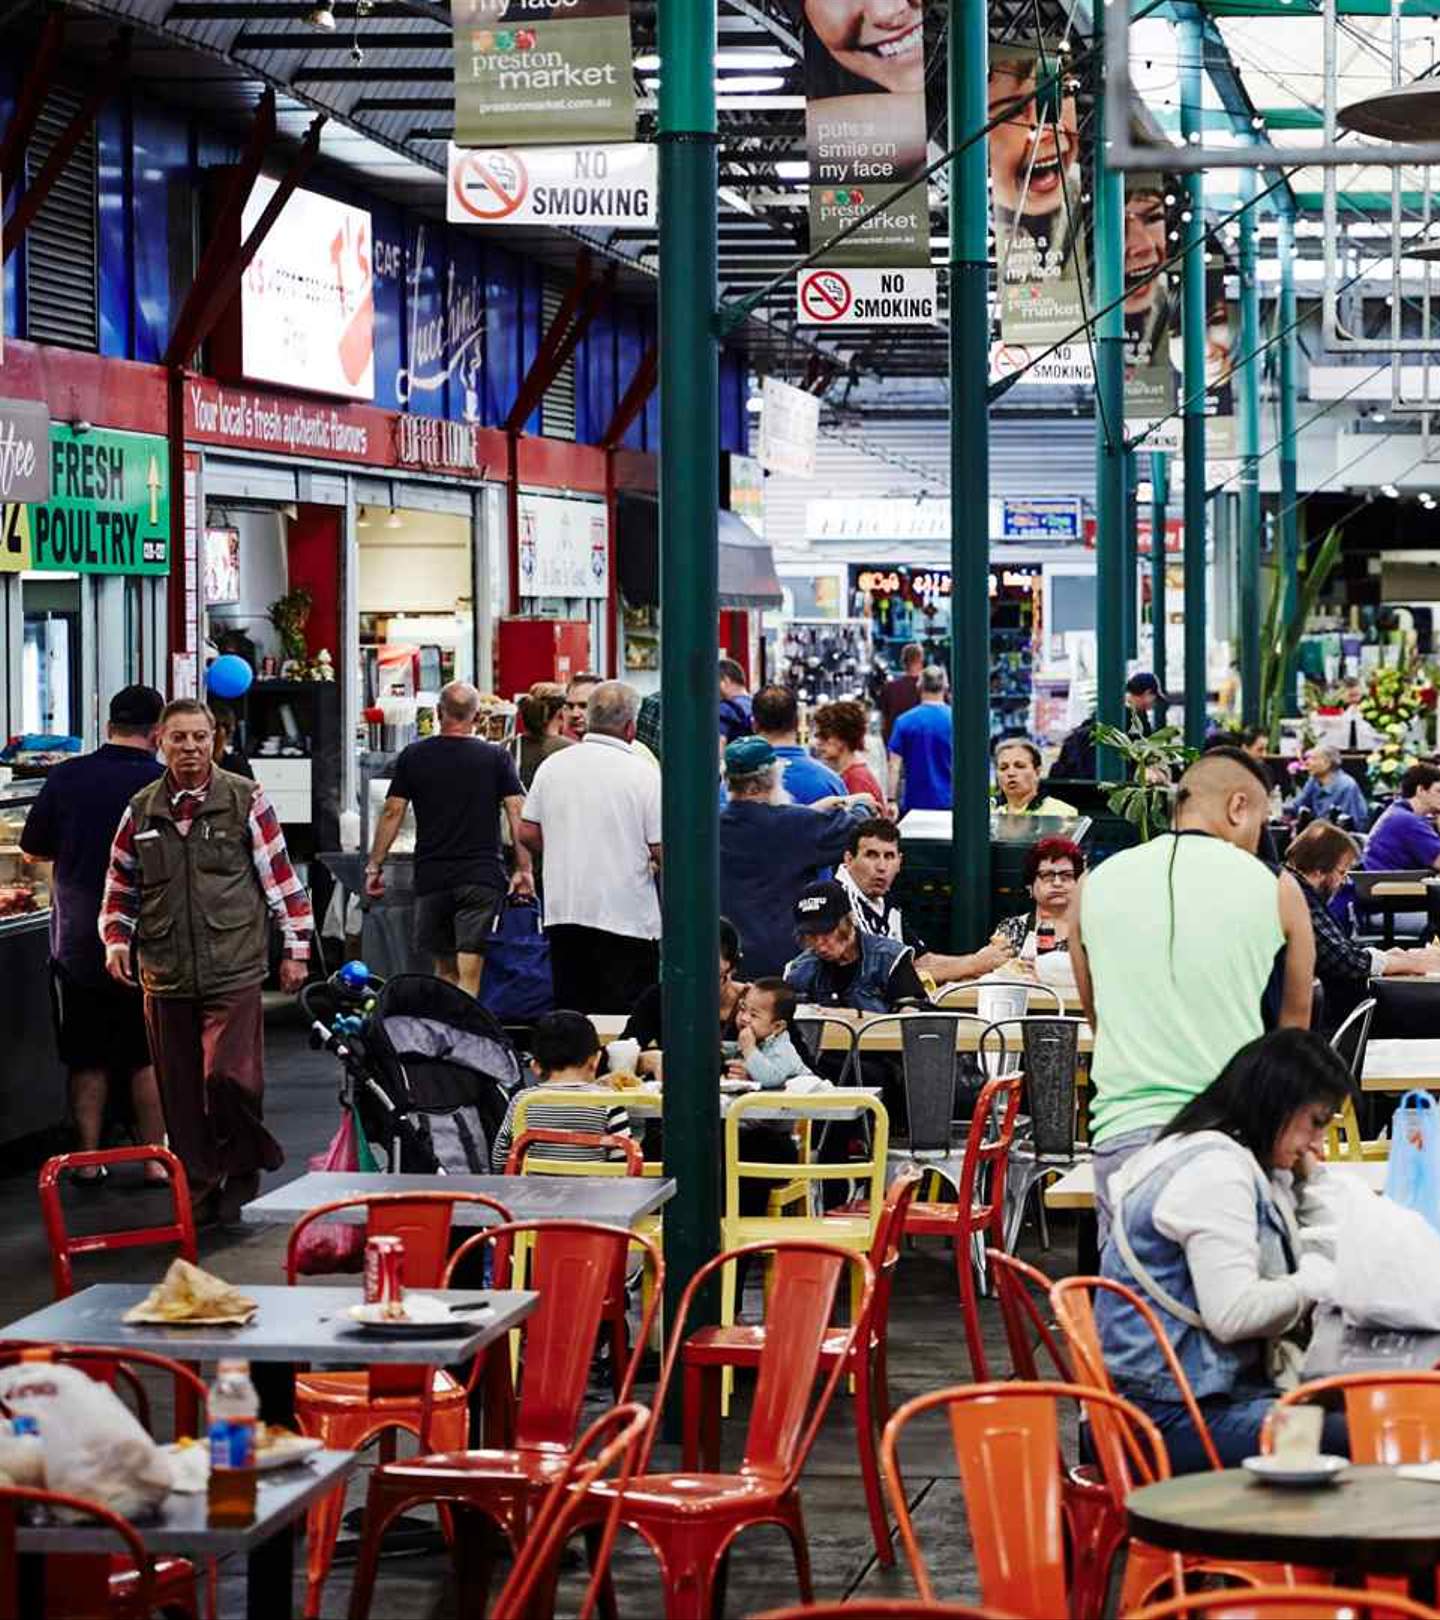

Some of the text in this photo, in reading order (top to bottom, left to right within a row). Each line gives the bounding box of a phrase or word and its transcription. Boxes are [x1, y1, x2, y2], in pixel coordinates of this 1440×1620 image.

[472, 51, 562, 77] preston
[500, 63, 616, 90] market
[818, 143, 896, 158] smile on
[575, 151, 607, 179] NO
[819, 161, 893, 181] my face
[532, 187, 648, 216] SMOKING
[881, 275, 904, 293] NO
[854, 299, 932, 318] SMOKING
[1053, 346, 1071, 360] NO
[1033, 364, 1092, 379] SMOKING
[190, 384, 217, 432] Your
[52, 441, 124, 501] FRESH
[35, 507, 138, 567] POULTRY
